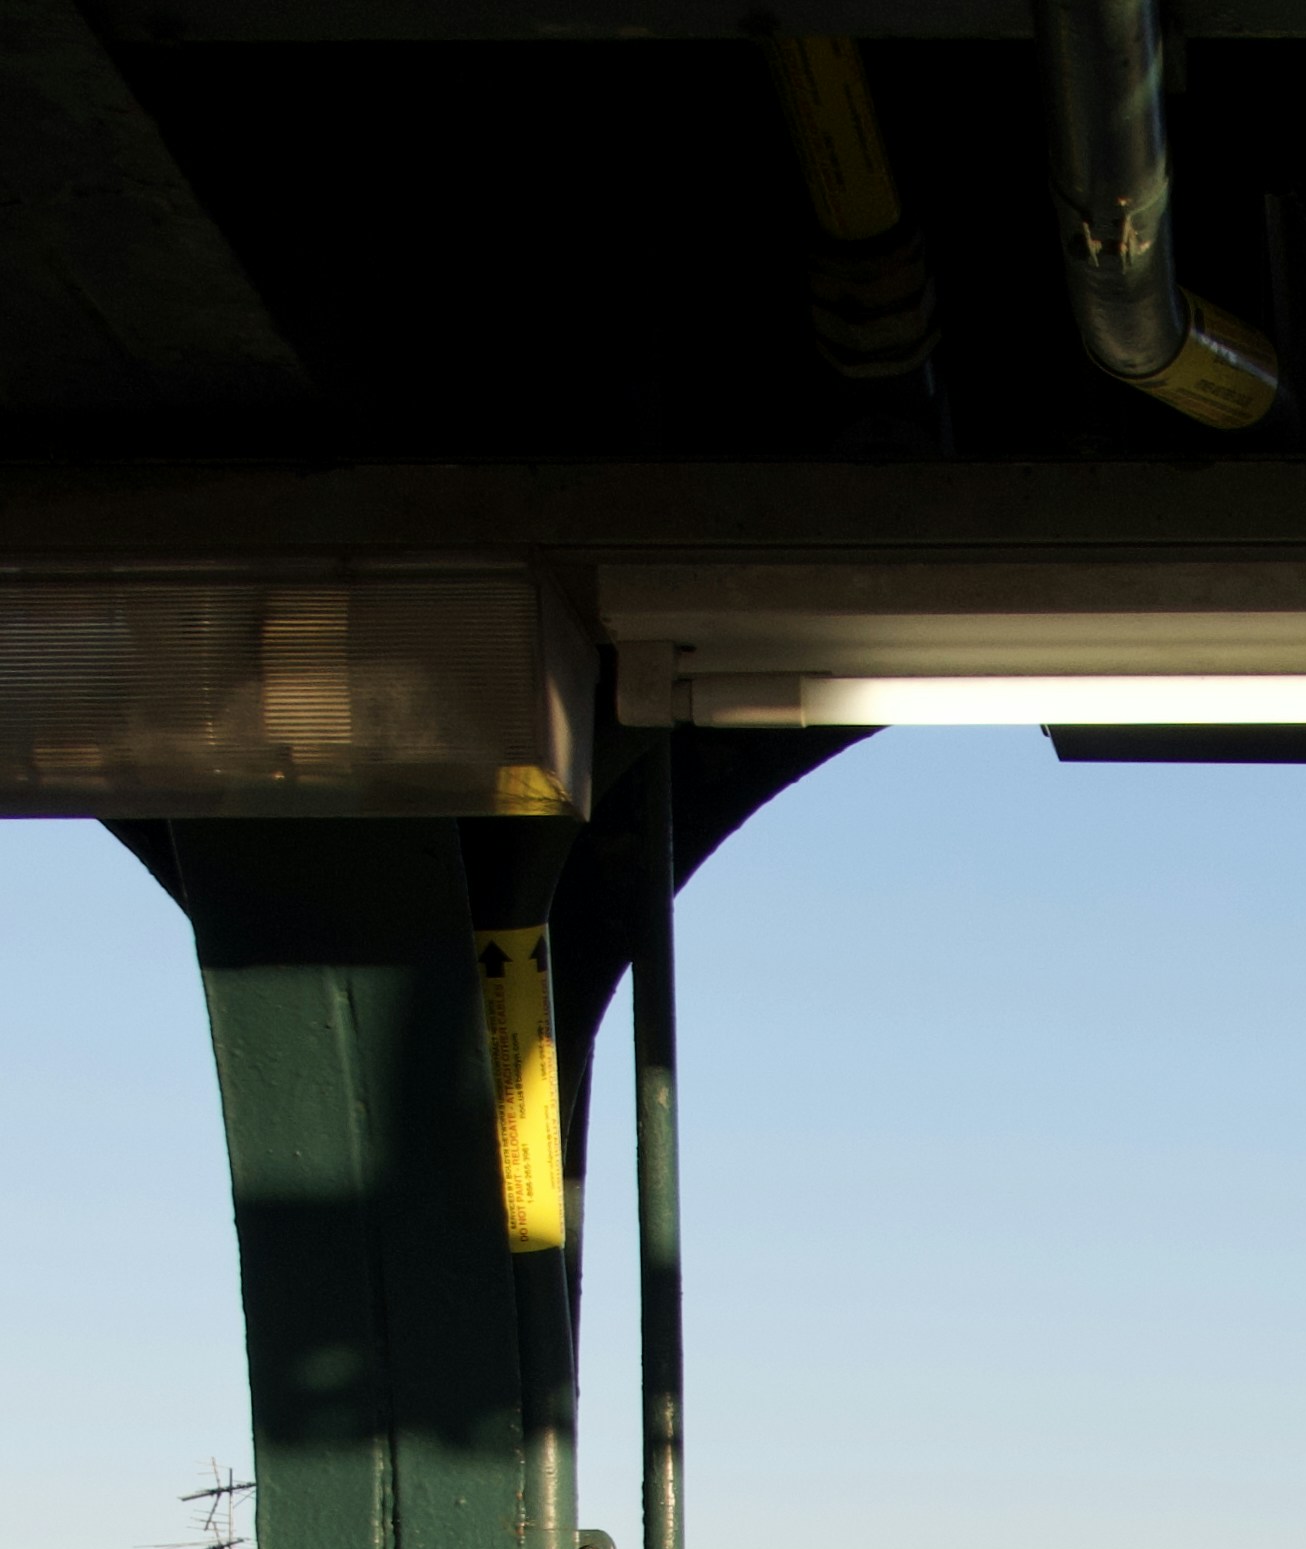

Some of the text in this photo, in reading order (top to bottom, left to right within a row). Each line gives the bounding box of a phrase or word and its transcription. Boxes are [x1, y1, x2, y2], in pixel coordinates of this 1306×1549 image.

[507, 1112, 521, 1165] RELOCATE
[512, 1173, 524, 1202] PAINT
[515, 1205, 527, 1225] NOT
[518, 1228, 529, 1242] DO
